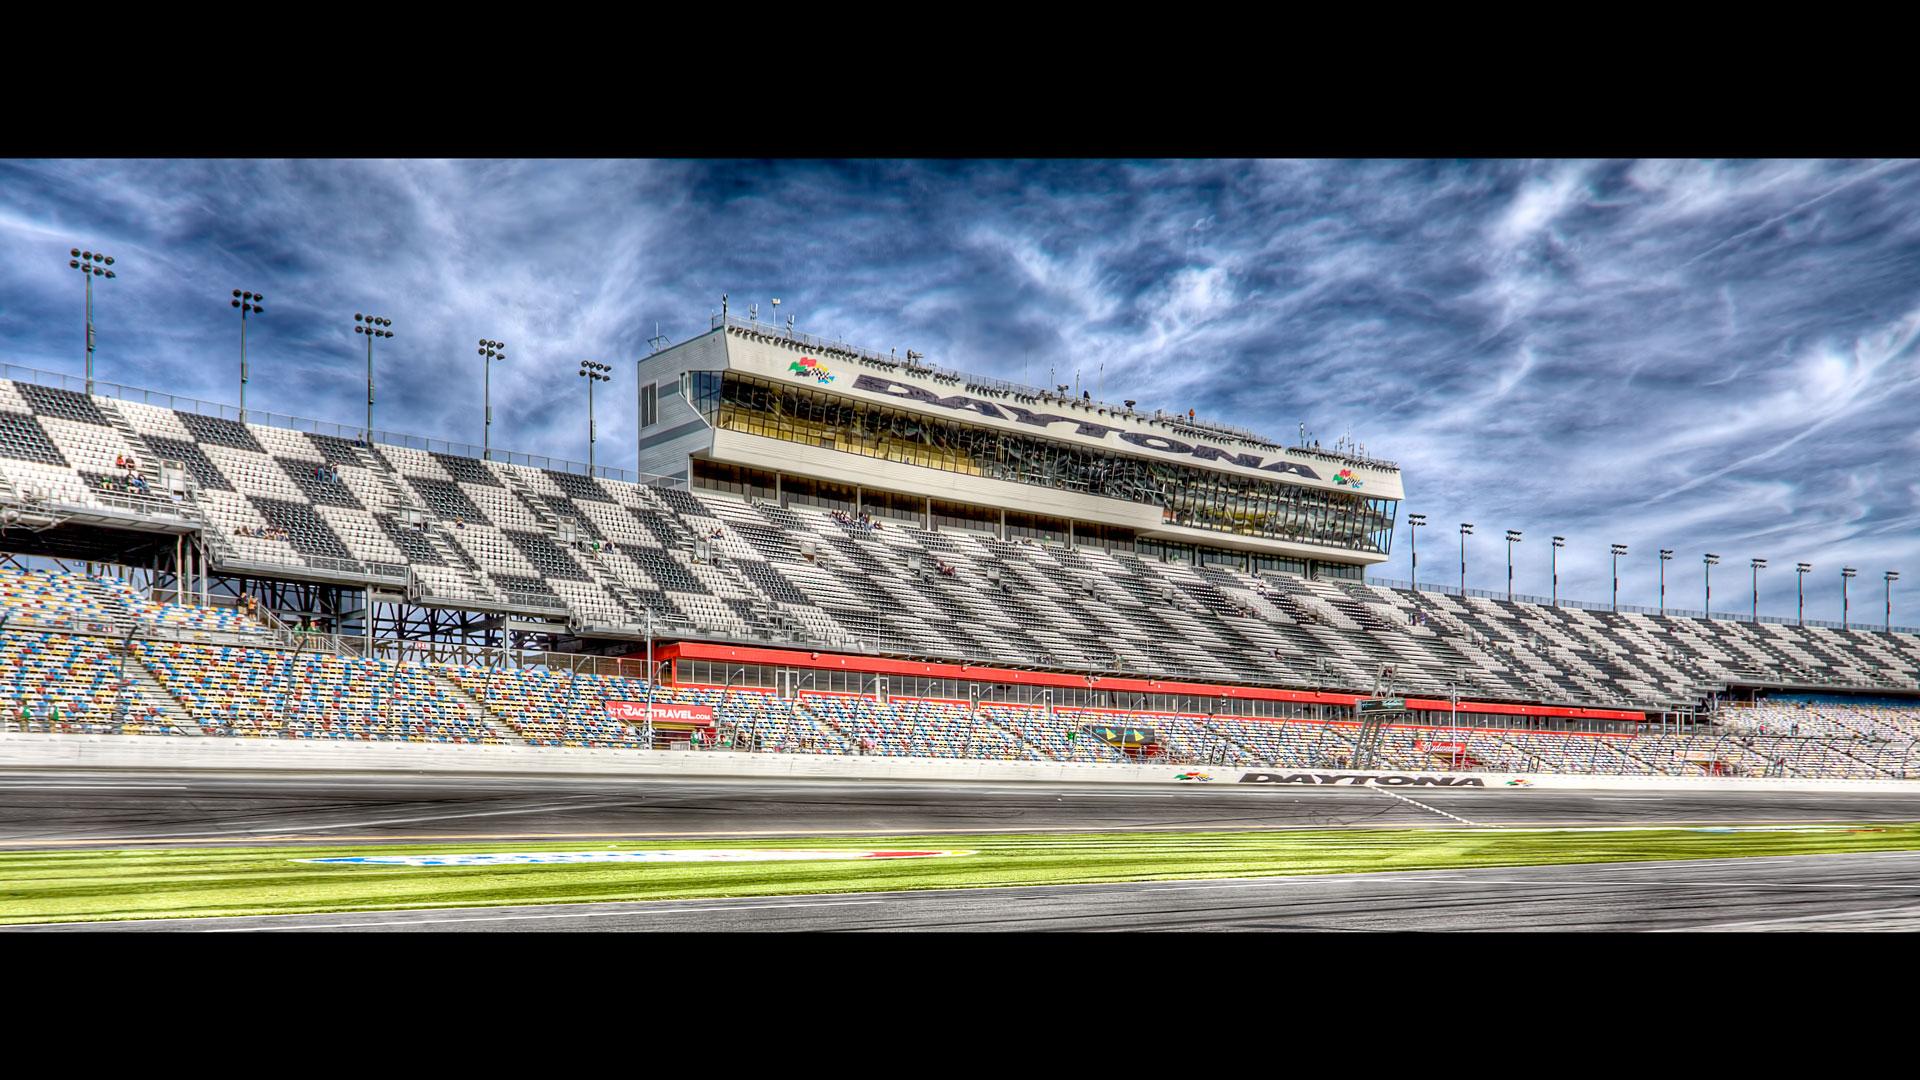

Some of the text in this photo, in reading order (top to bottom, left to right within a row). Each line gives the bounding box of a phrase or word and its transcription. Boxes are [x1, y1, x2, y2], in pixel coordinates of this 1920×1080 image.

[852, 374, 1321, 480] DAYTONA
[607, 704, 710, 719] MYRACTRAVEL.COM
[1420, 741, 1462, 752] Budwei
[1239, 773, 1485, 786] DAYTONA
